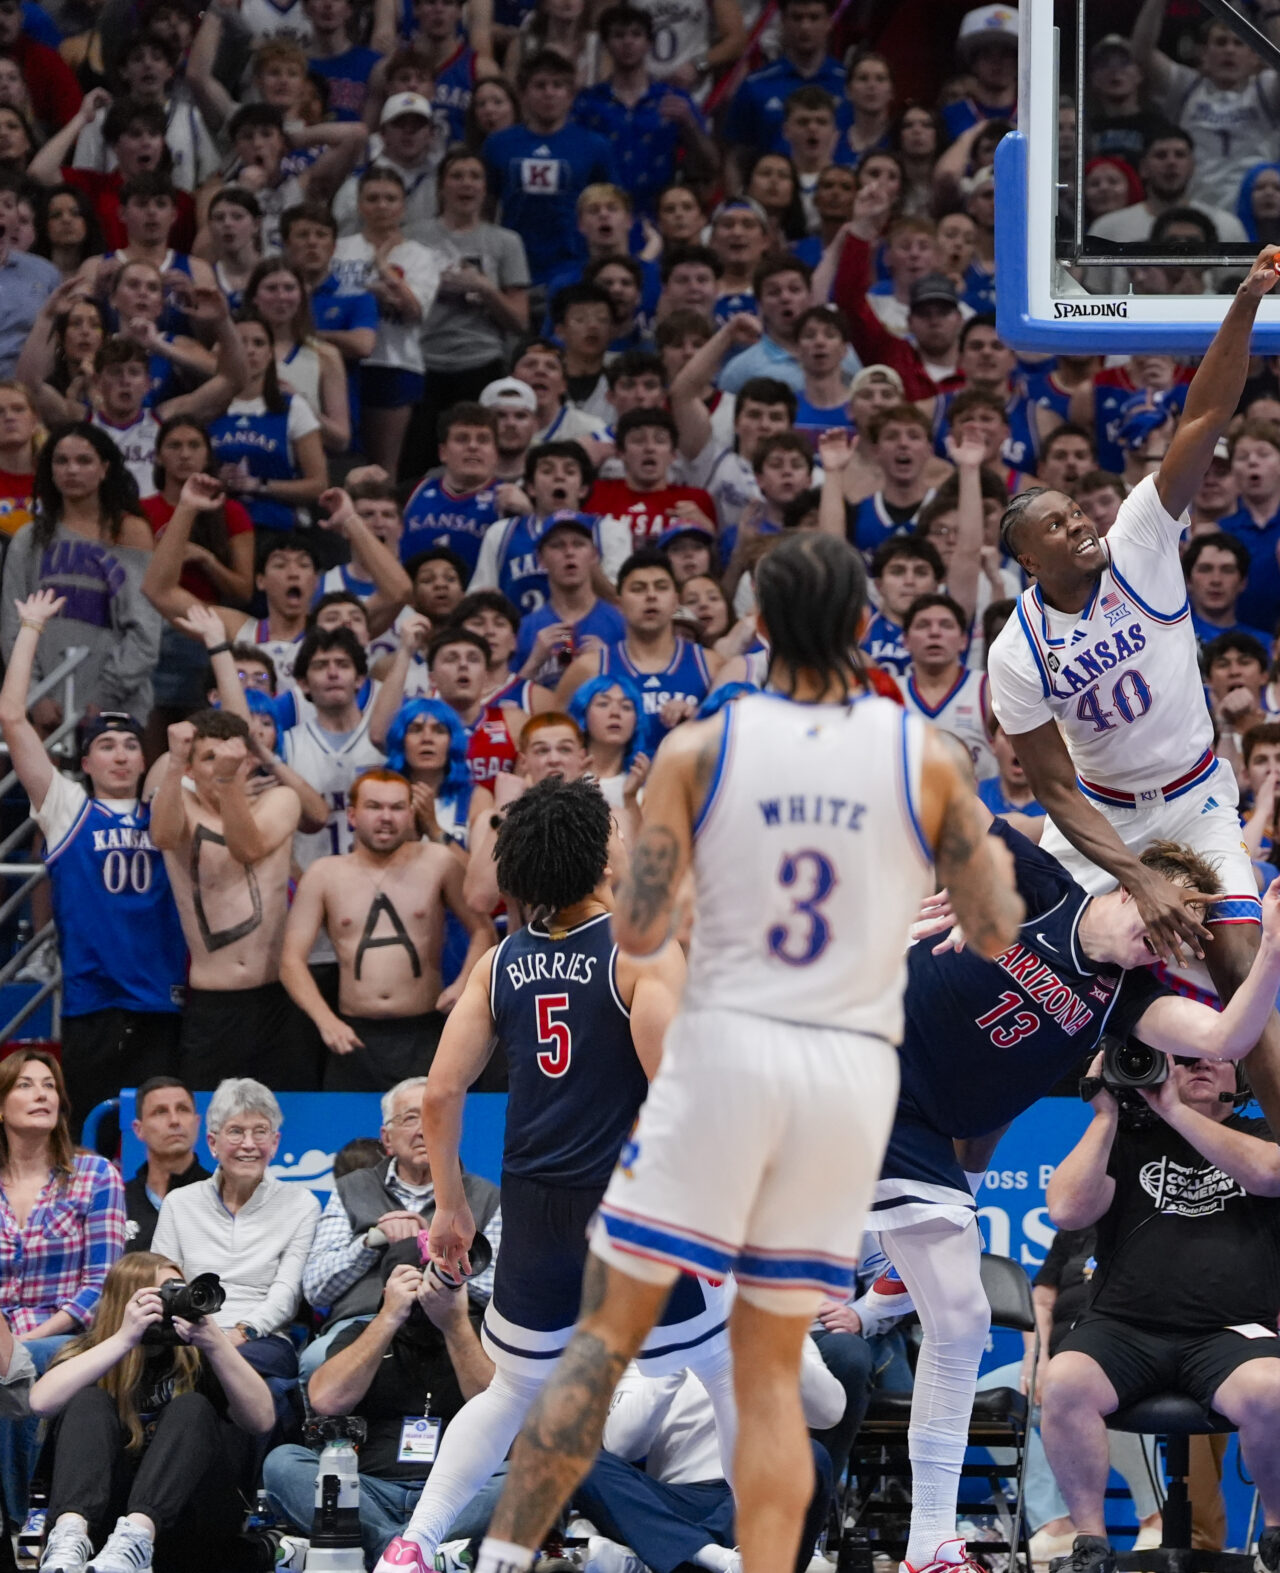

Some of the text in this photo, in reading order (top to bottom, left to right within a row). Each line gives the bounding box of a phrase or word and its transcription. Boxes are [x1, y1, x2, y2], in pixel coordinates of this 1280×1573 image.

[528, 165, 551, 188] K
[1053, 302, 1128, 319] SPALDING
[1076, 668, 1154, 735] 40
[758, 797, 869, 832] WHITE
[1139, 788, 1158, 803] KU
[93, 828, 158, 853] KANSA
[102, 850, 153, 895] 00
[766, 848, 838, 967] 3
[353, 892, 421, 981] A
[506, 952, 598, 991] BURRIES
[995, 942, 1095, 1037] ARIZONA
[535, 993, 573, 1079] 5
[975, 990, 1041, 1049] 13
[1165, 1177, 1234, 1201] GAMEDAY
